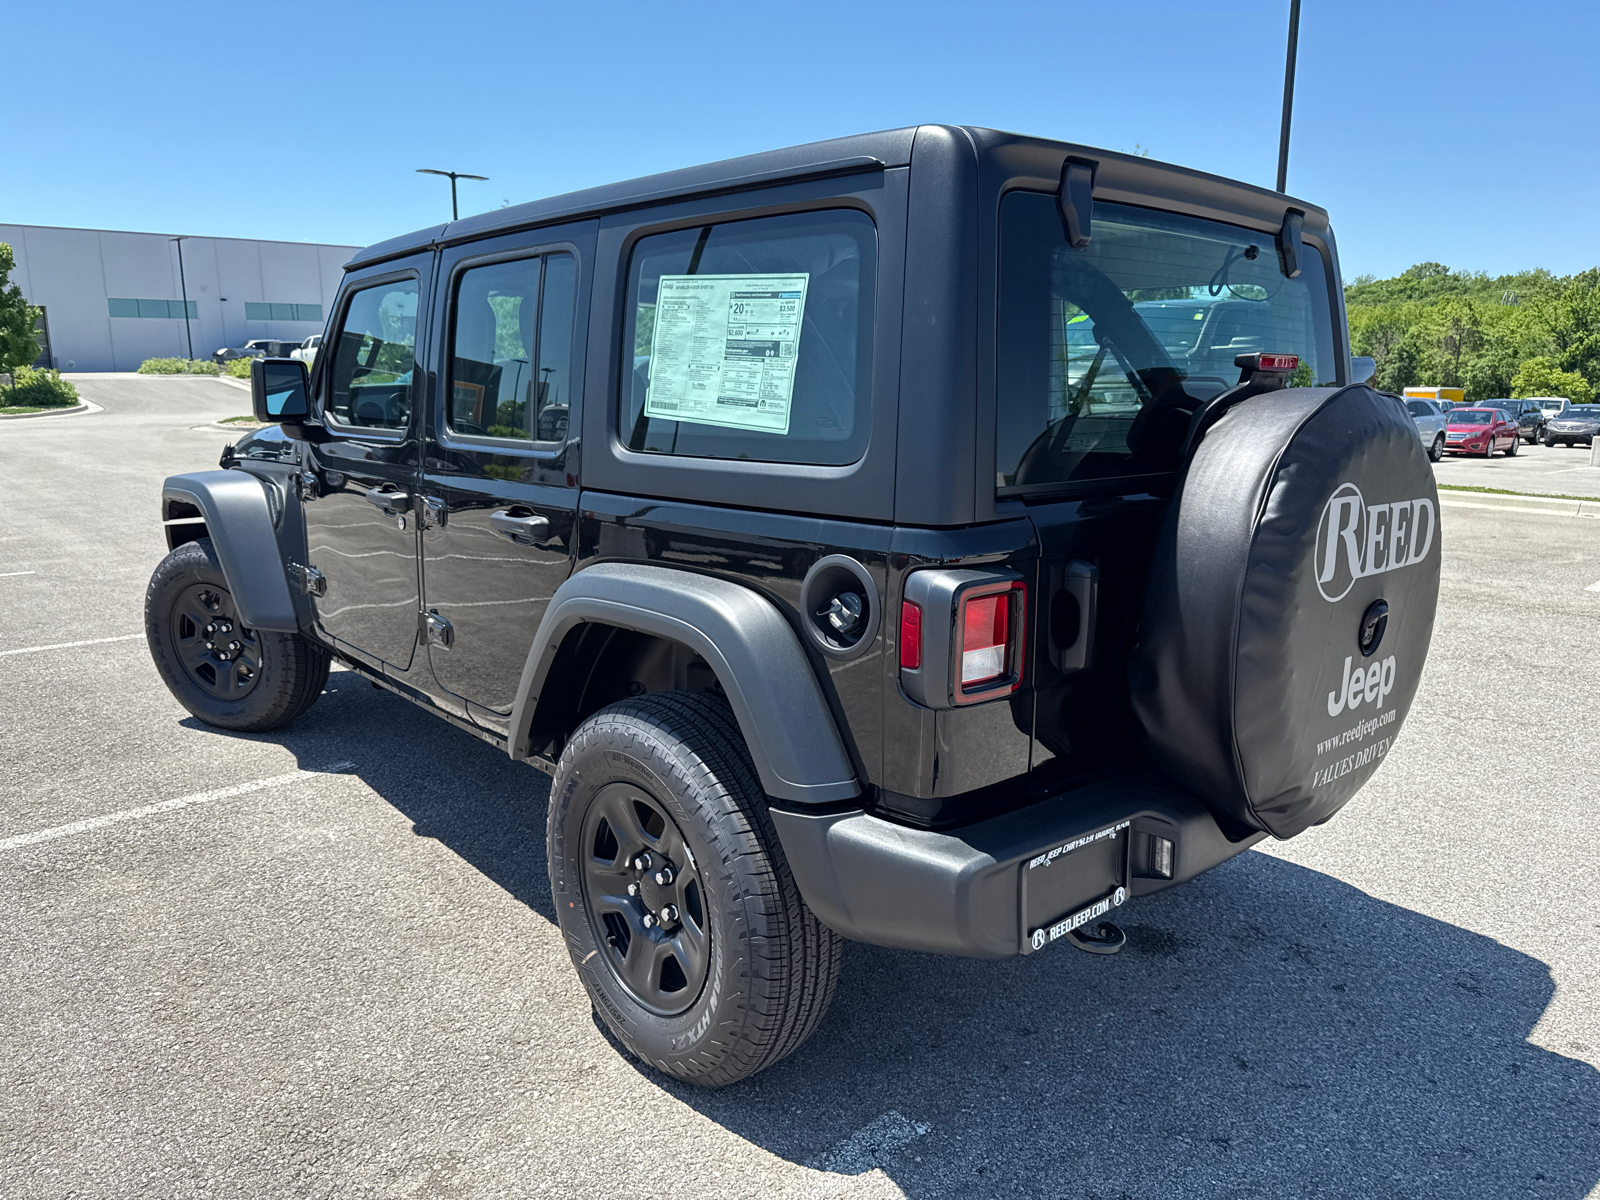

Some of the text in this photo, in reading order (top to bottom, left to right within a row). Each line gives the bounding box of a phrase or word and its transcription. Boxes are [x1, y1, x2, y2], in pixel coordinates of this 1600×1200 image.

[733, 302, 744, 314] 20
[1319, 495, 1435, 584] REED
[1327, 655, 1396, 717] Jeep
[1316, 709, 1396, 756] www.reedjeep.com
[612, 753, 654, 780] All-Weather
[1312, 735, 1392, 789] VALUES DRIVEN
[1029, 854, 1046, 870] REED
[1049, 898, 1110, 942] REEDJEEP.COM
